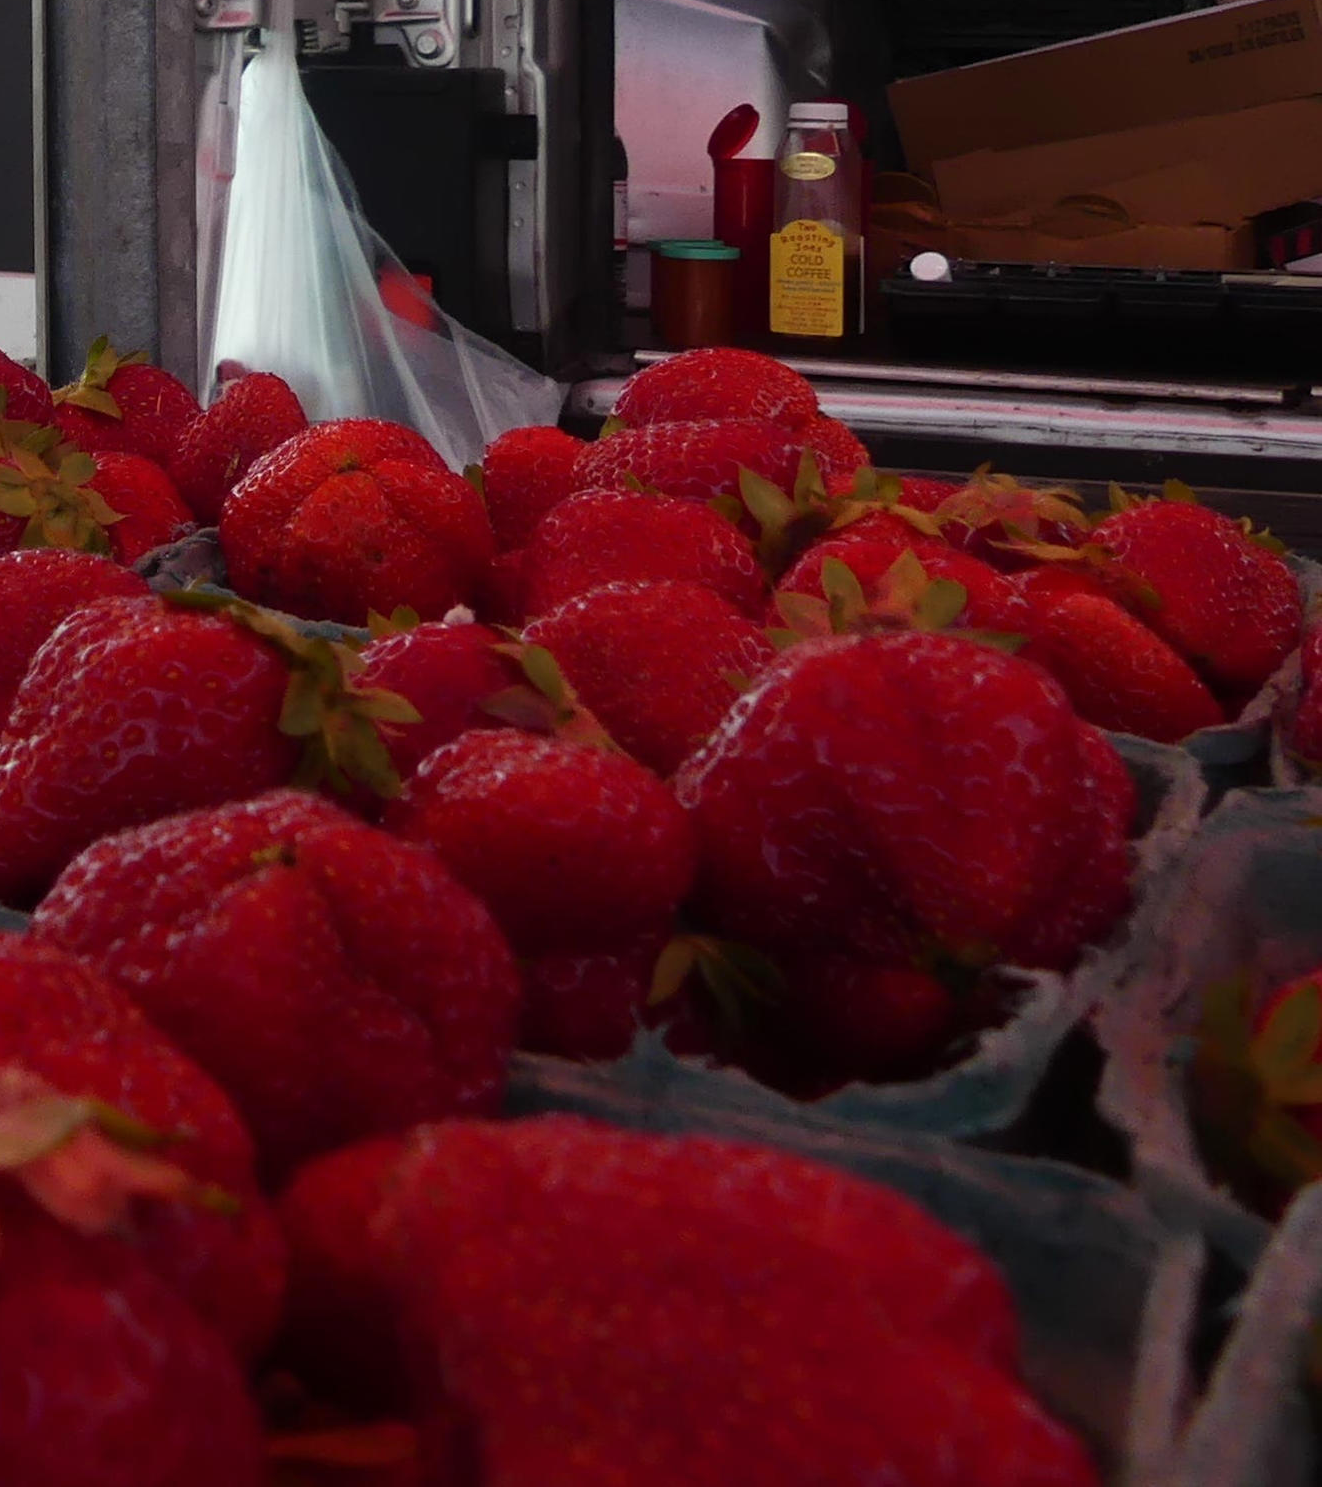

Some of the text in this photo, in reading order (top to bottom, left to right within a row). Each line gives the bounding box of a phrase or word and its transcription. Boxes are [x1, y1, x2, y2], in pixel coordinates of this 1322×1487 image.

[798, 222, 817, 231] Two
[791, 254, 824, 266] COLD
[786, 267, 831, 280] COFFEE
